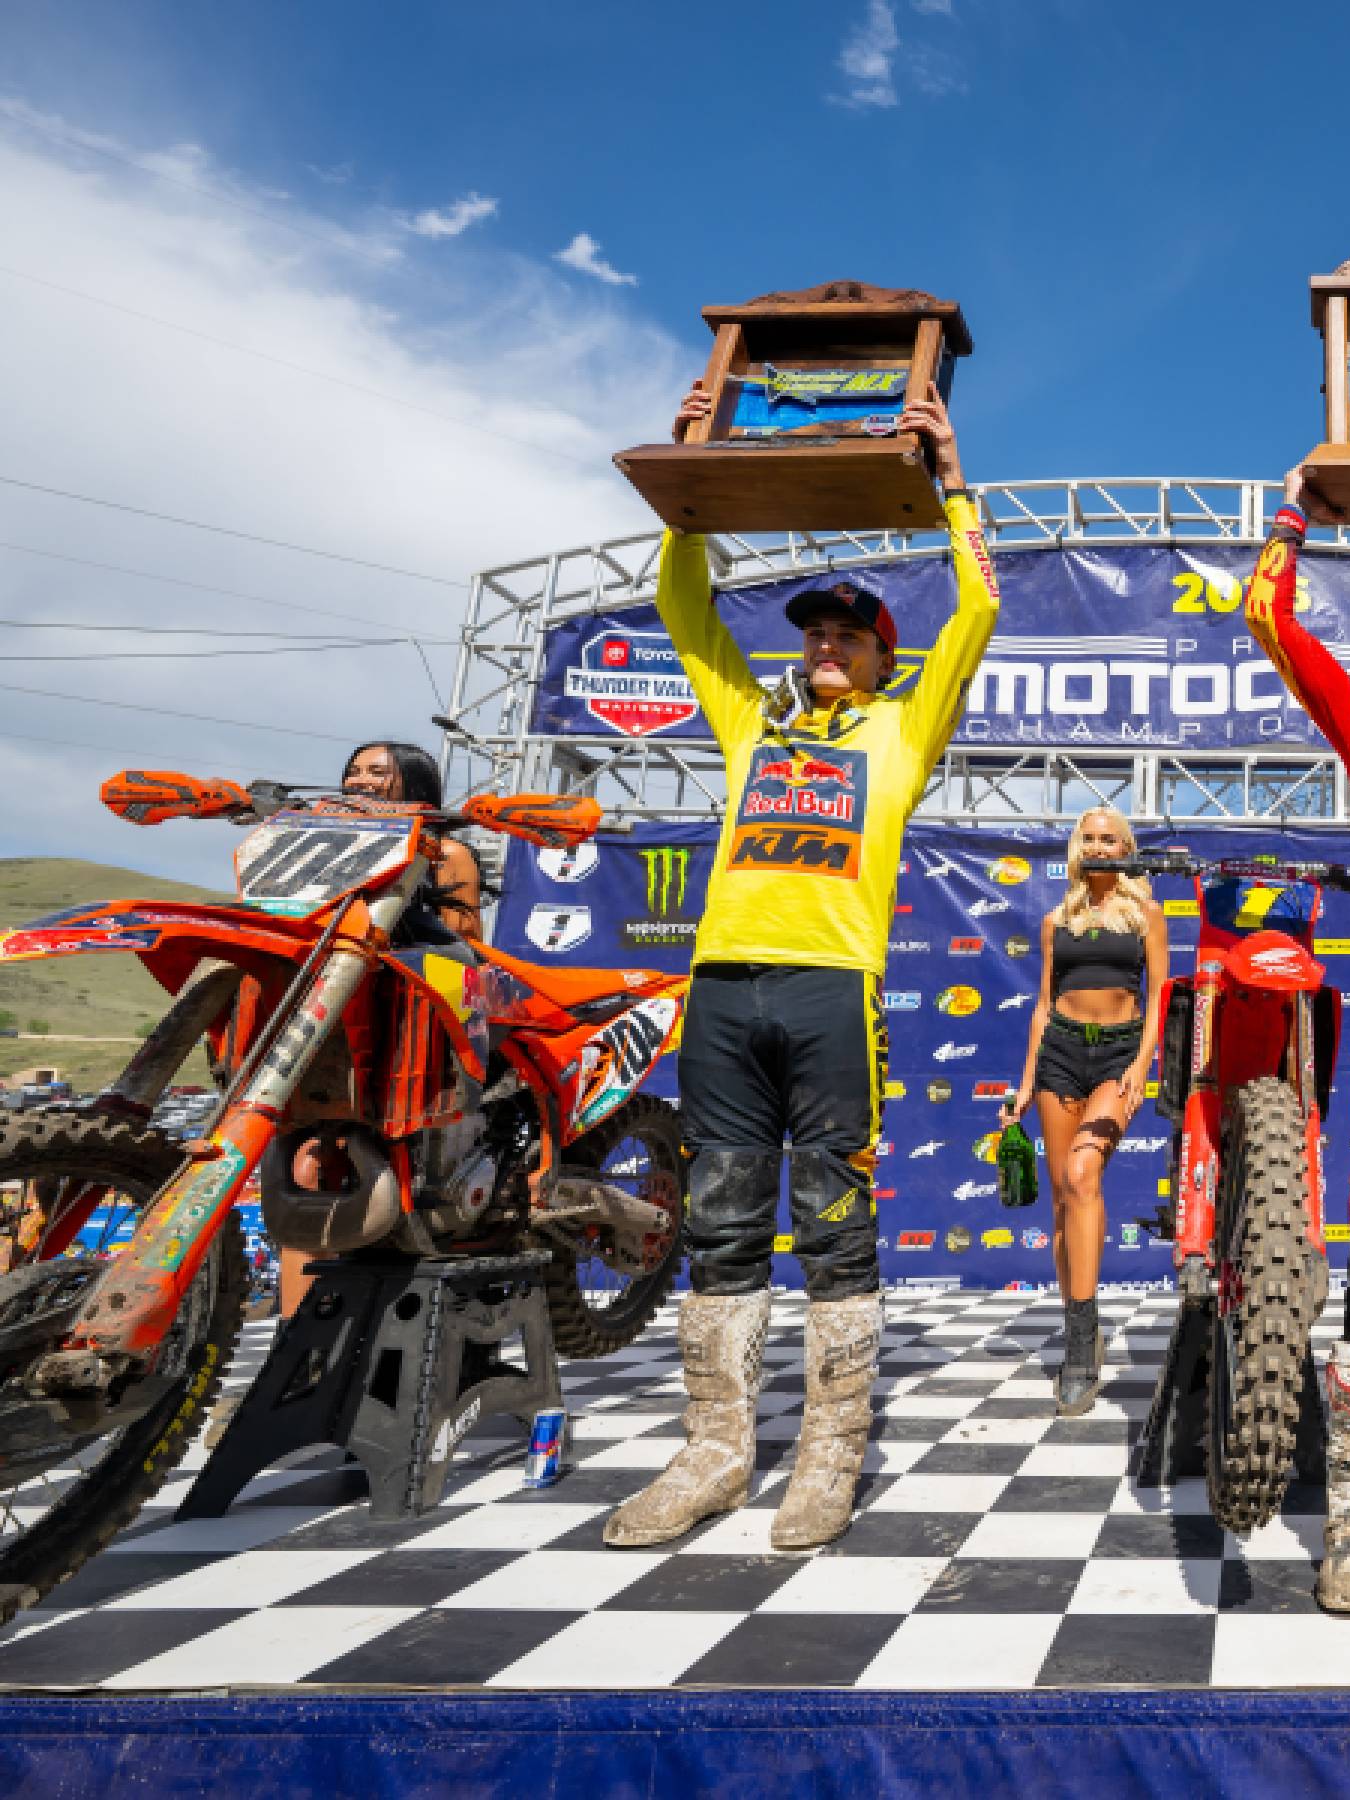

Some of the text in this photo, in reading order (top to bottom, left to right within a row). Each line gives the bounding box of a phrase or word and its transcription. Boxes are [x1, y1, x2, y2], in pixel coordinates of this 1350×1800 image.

[744, 787, 854, 822] Red Bull
[733, 828, 852, 870] KTM
